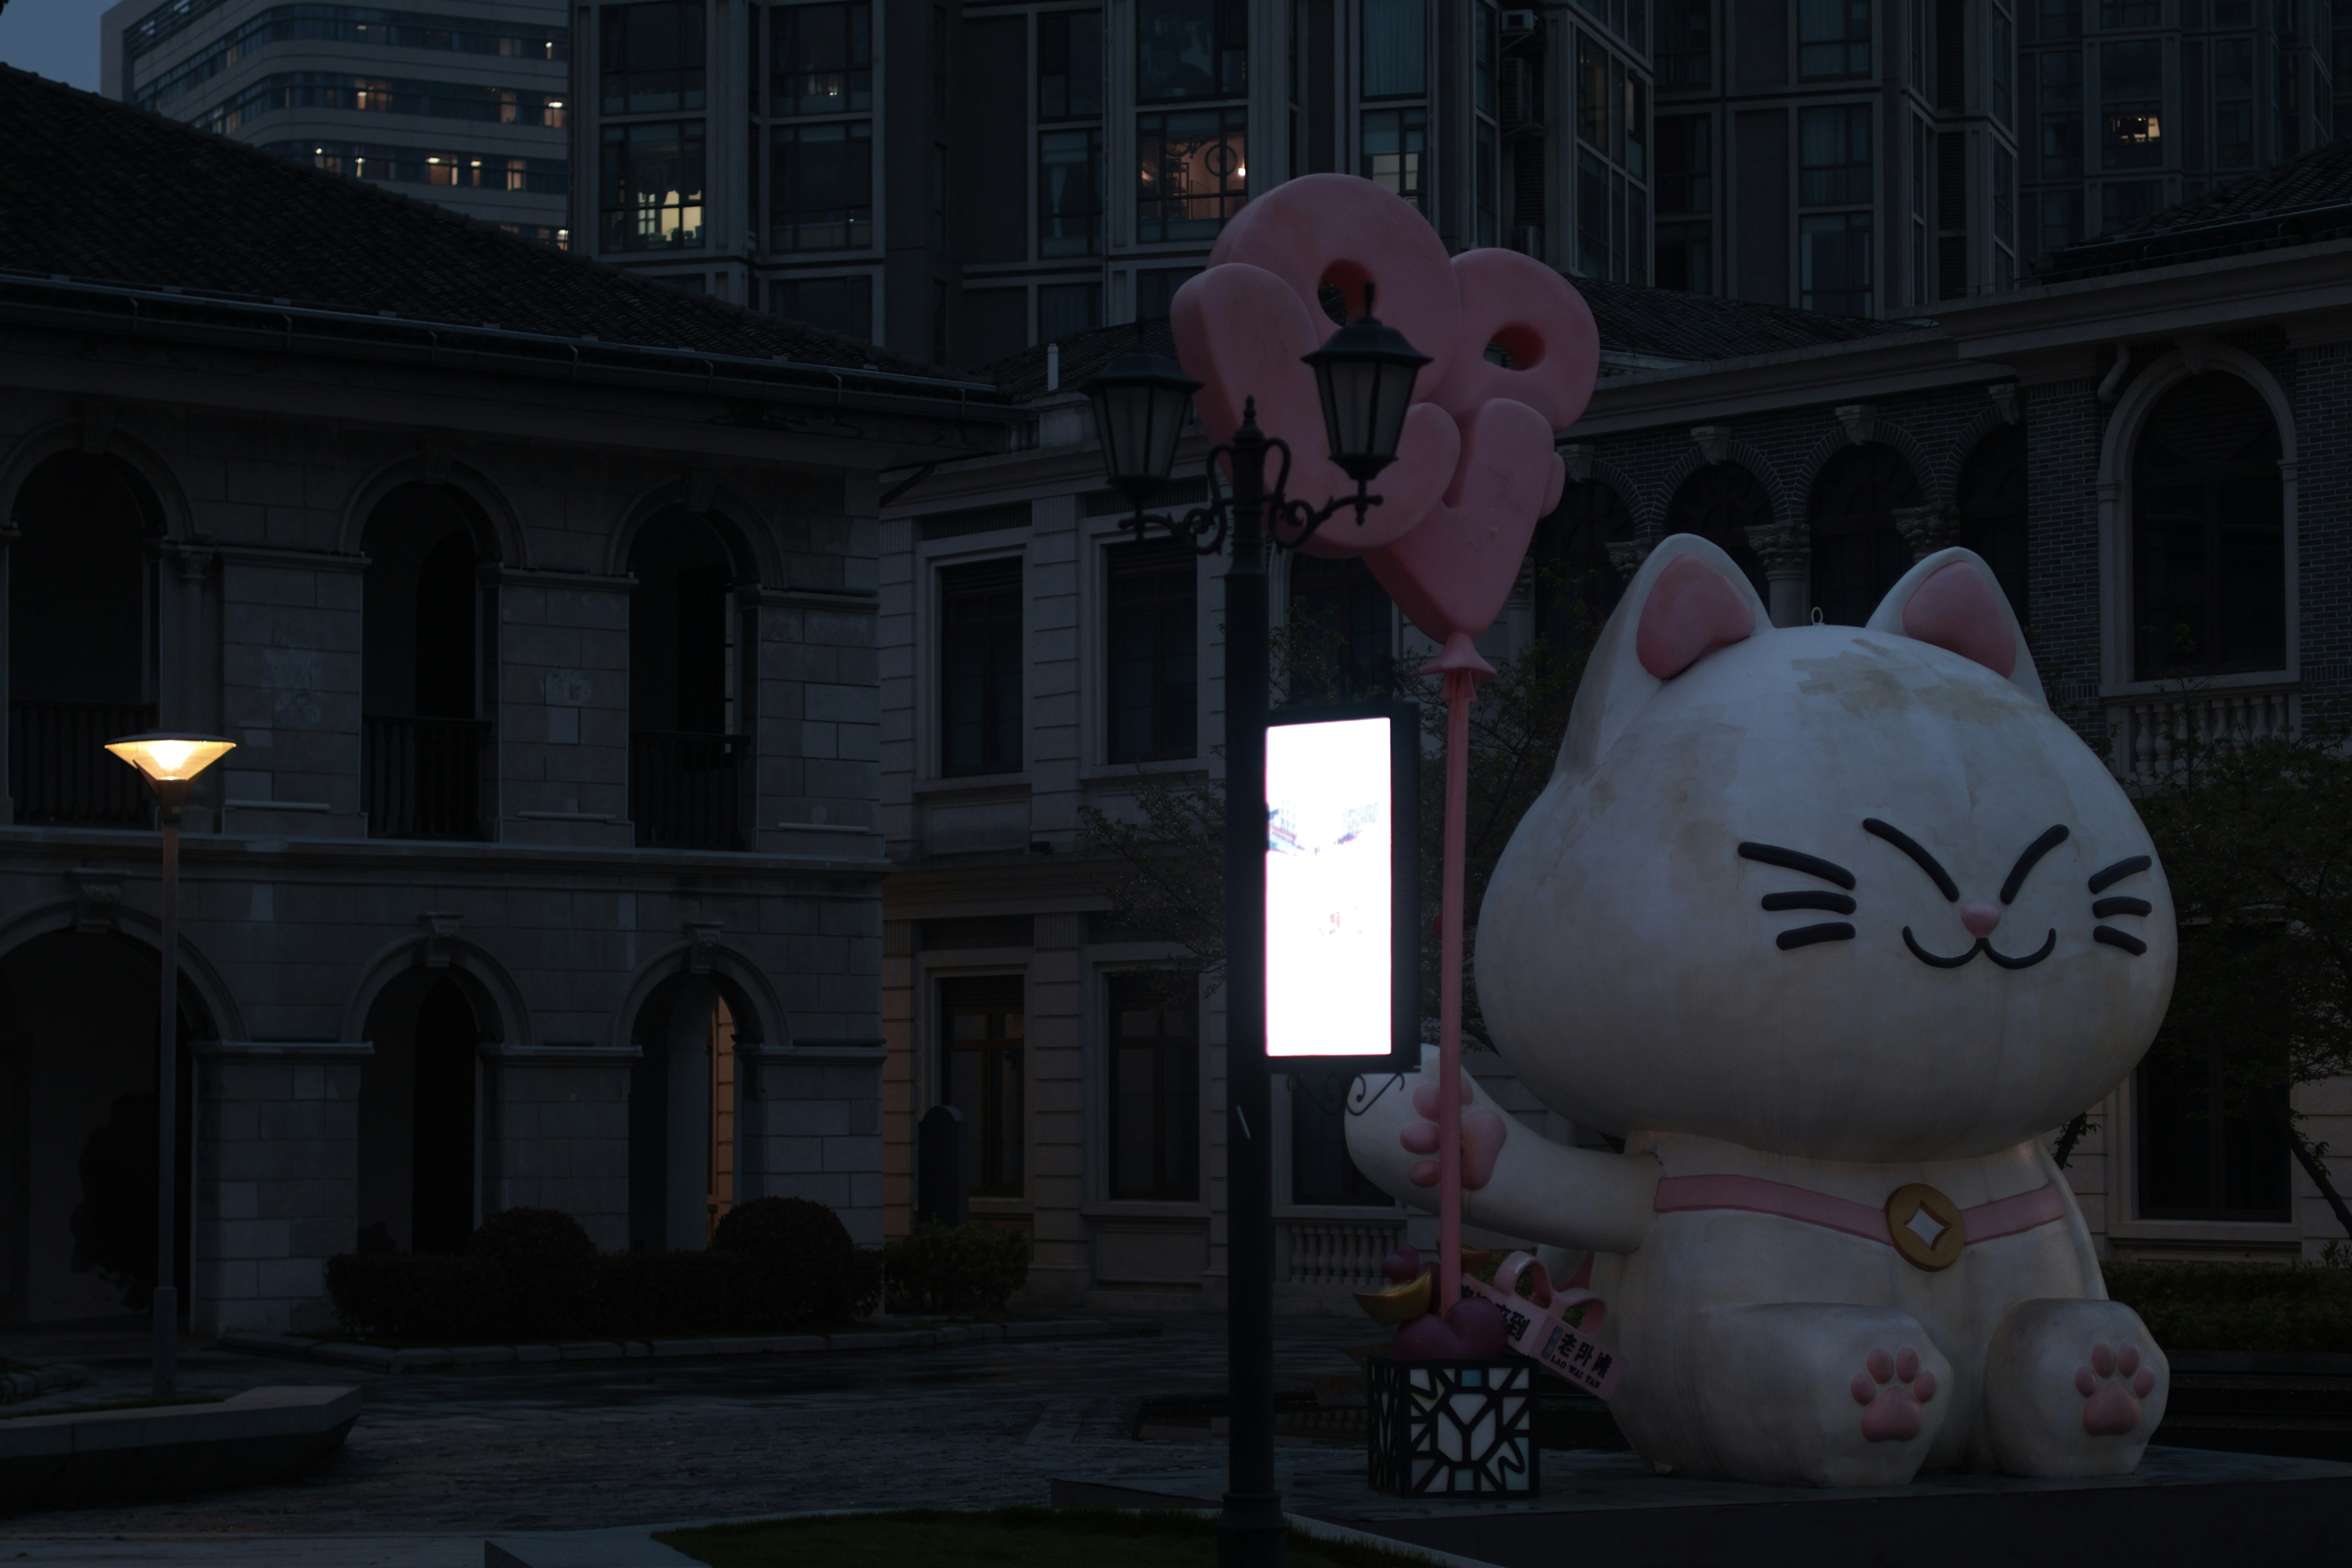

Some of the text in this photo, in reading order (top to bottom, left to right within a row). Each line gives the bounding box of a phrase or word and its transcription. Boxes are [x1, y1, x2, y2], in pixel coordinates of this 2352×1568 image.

[1550, 1355, 1601, 1388] LAO WAI TAN
